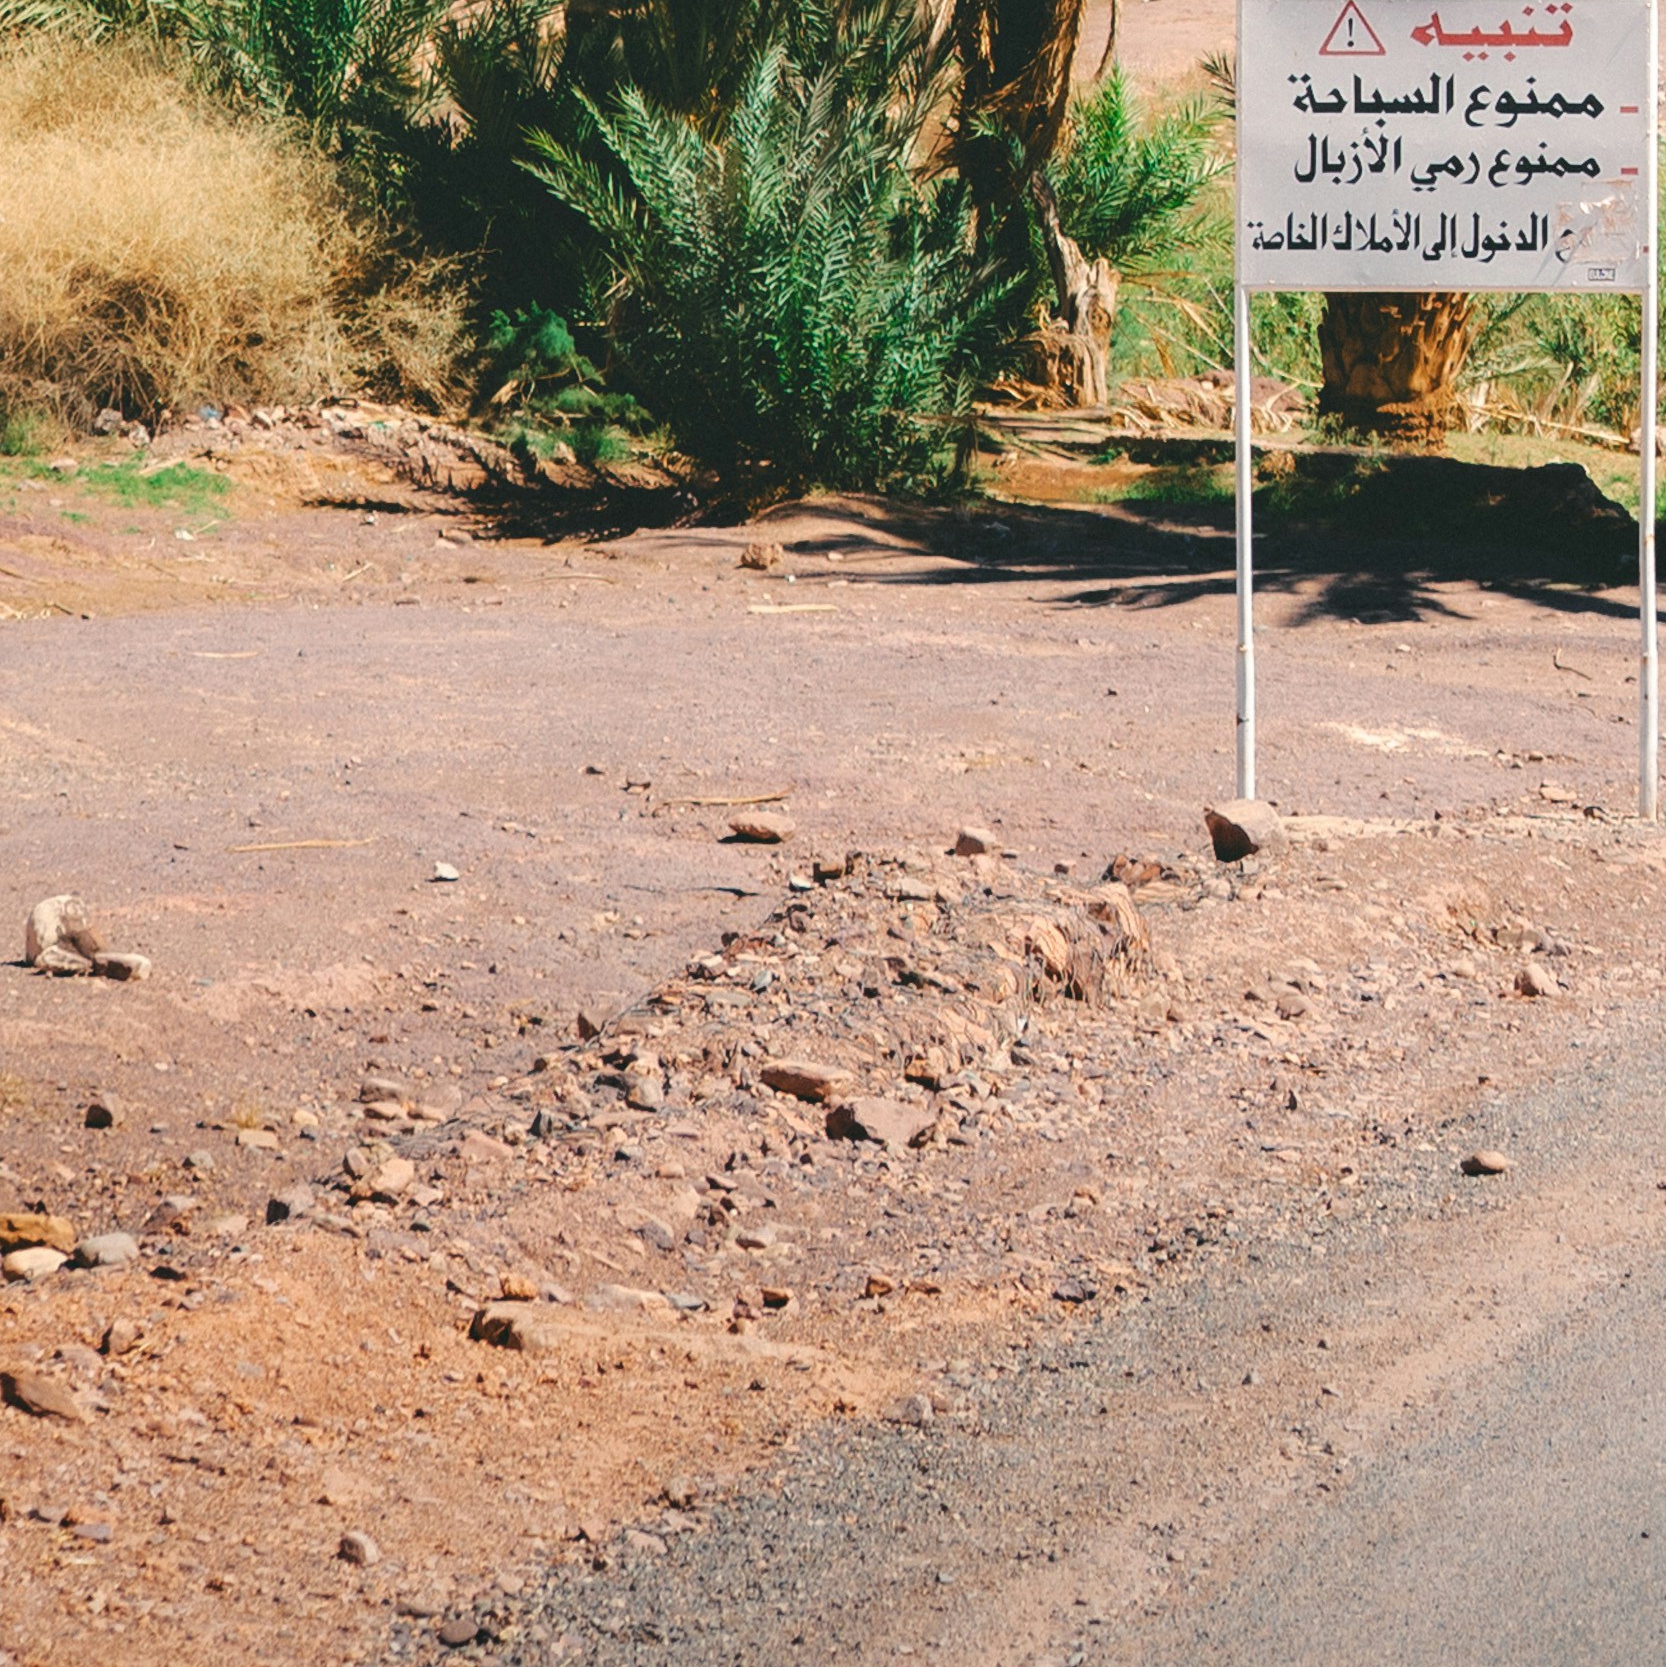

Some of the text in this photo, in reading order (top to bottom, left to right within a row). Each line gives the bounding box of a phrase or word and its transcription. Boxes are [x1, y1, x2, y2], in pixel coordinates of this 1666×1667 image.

[1410, 2, 1573, 62] تنبيه
[1287, 72, 1605, 128] ممنوع السباحة
[1294, 128, 1601, 193] ممنوع رمي الأزبال
[1247, 211, 1328, 251] الخاصة
[1332, 208, 1421, 254] الأملاك
[1422, 211, 1457, 261] إلى
[1461, 211, 1548, 263] الدخول
